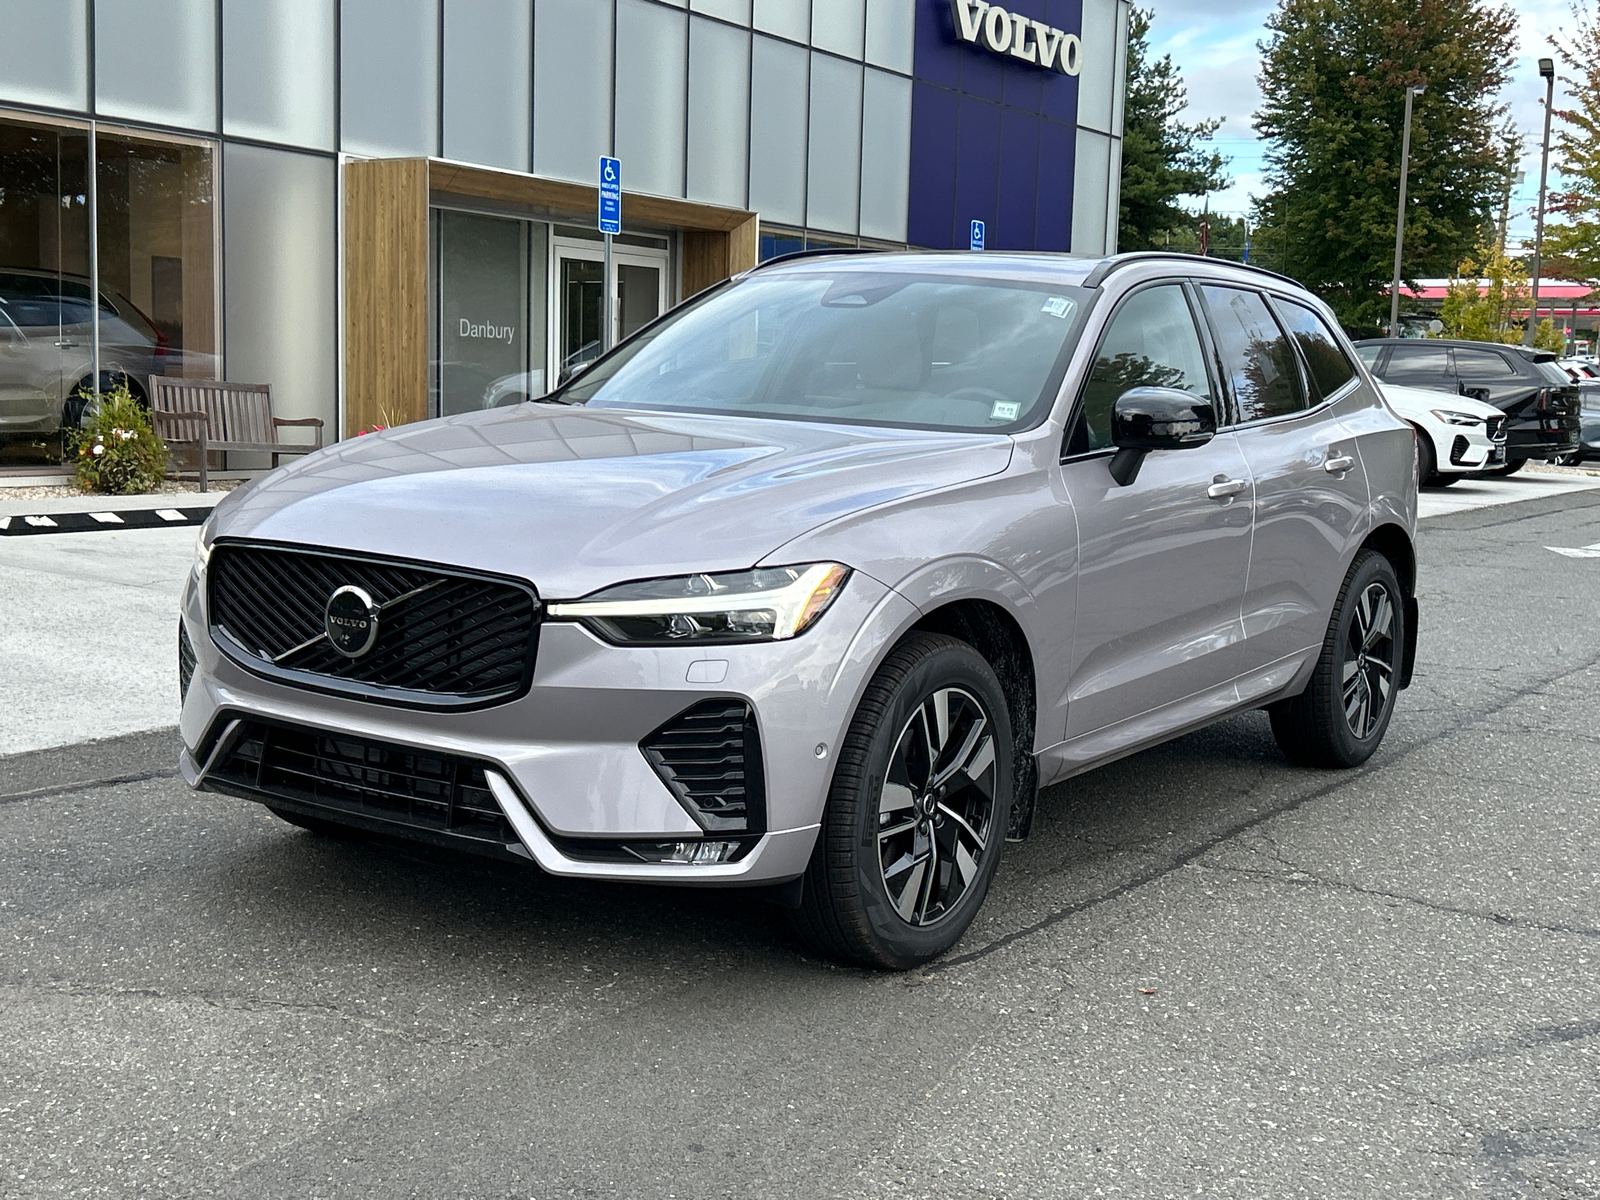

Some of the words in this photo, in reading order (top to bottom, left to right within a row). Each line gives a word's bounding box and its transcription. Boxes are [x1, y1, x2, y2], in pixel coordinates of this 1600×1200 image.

[953, 0, 1083, 77] VOLVO
[459, 318, 515, 345] Danbury
[329, 615, 367, 629] VOLVO
